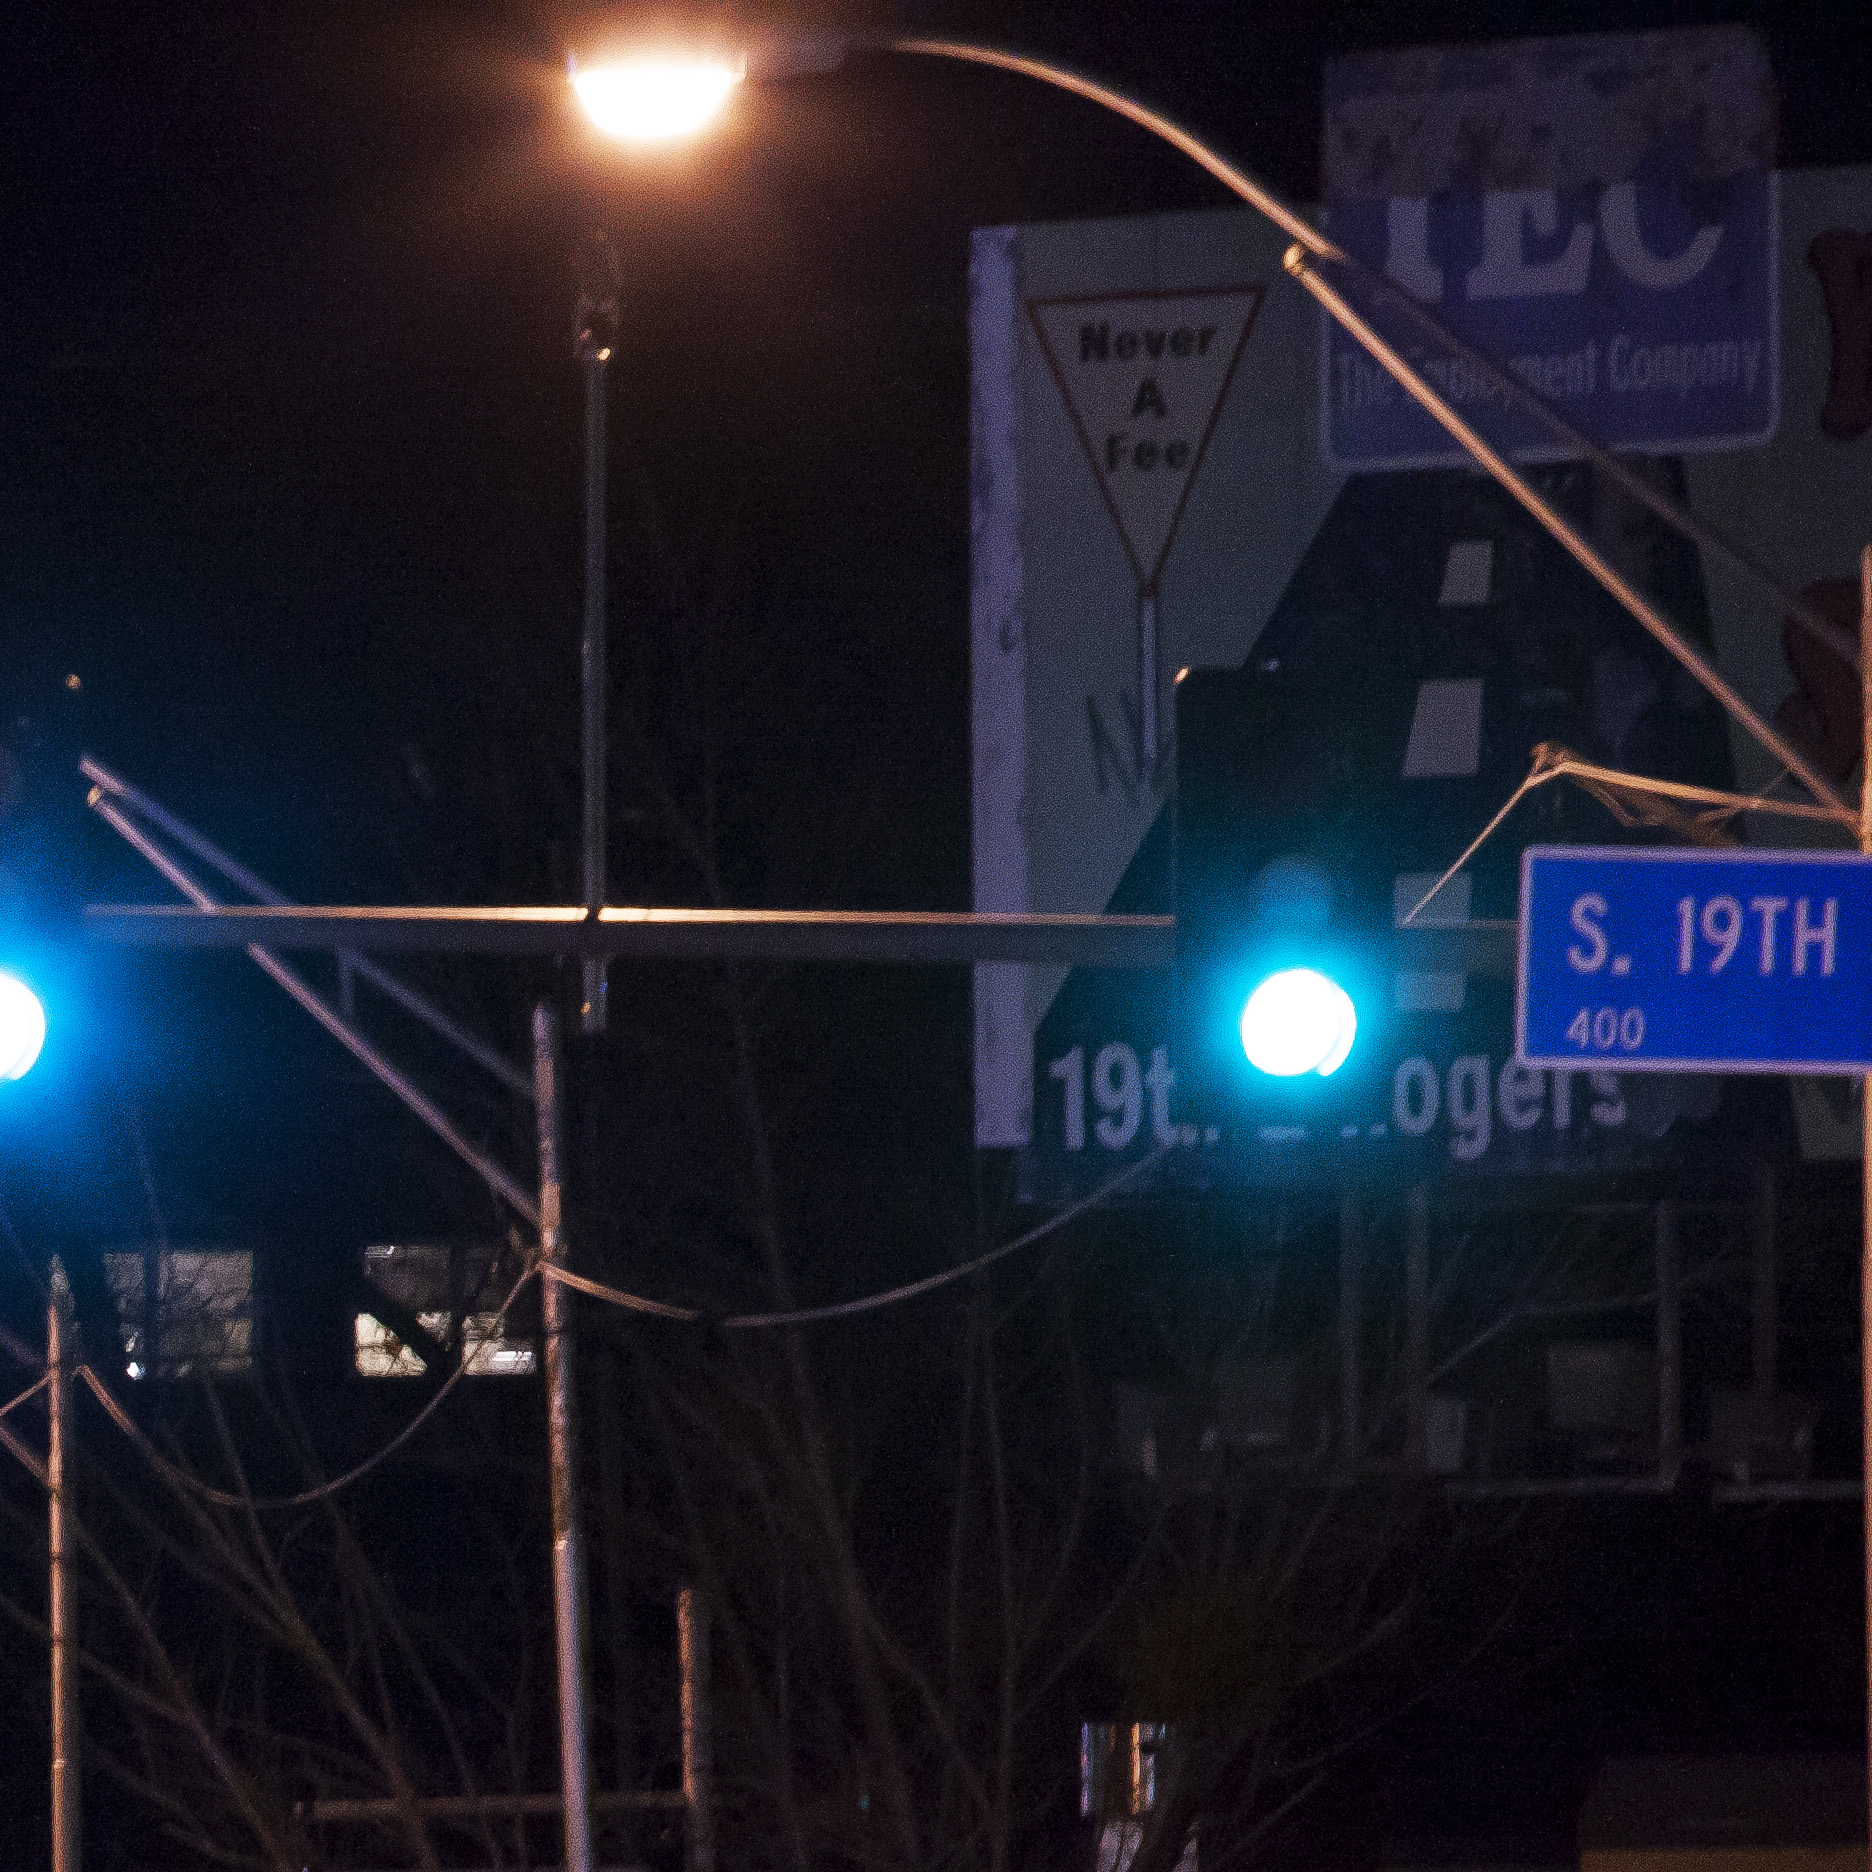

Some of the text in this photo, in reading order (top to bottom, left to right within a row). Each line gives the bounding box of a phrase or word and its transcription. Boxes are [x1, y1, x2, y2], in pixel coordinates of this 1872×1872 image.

[1078, 322, 1218, 363] Never
[1131, 378, 1167, 418] A
[1106, 432, 1190, 471] Fee
[1567, 892, 1838, 978] S. 19TH
[1565, 1006, 1647, 1052] 400
[1050, 1041, 1220, 1151] 19t
